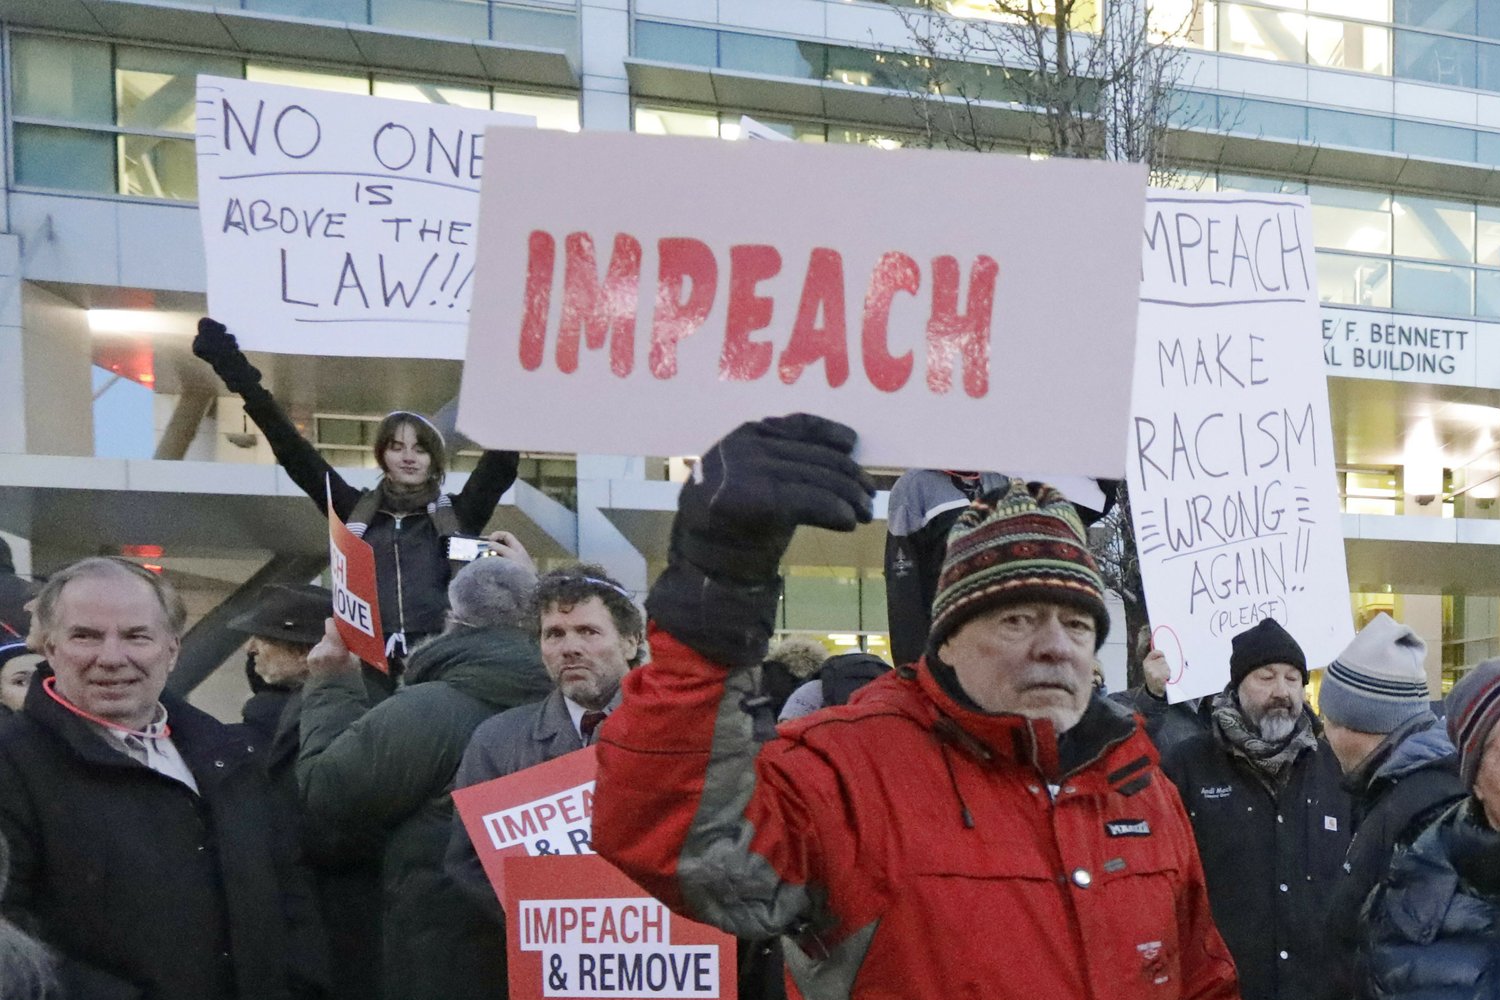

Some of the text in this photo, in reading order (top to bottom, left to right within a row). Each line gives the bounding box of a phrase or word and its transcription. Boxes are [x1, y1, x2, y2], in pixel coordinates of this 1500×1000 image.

[222, 98, 485, 179] NO ONE
[355, 182, 393, 205] IS
[222, 198, 472, 246] ABOVE THE
[280, 248, 474, 312] LAW!!
[518, 229, 999, 398] IMPEACH
[1346, 321, 1359, 342] F.
[1371, 323, 1468, 350] BENNETT
[1158, 333, 1270, 388] MAKE
[1354, 348, 1455, 374] BUILDING
[1134, 403, 1317, 491] RACISM
[1164, 480, 1286, 552] WRONG
[1190, 527, 1310, 614] AGAIN!!
[524, 905, 663, 944] IMPEACH
[548, 952, 712, 992] & REMOVE
